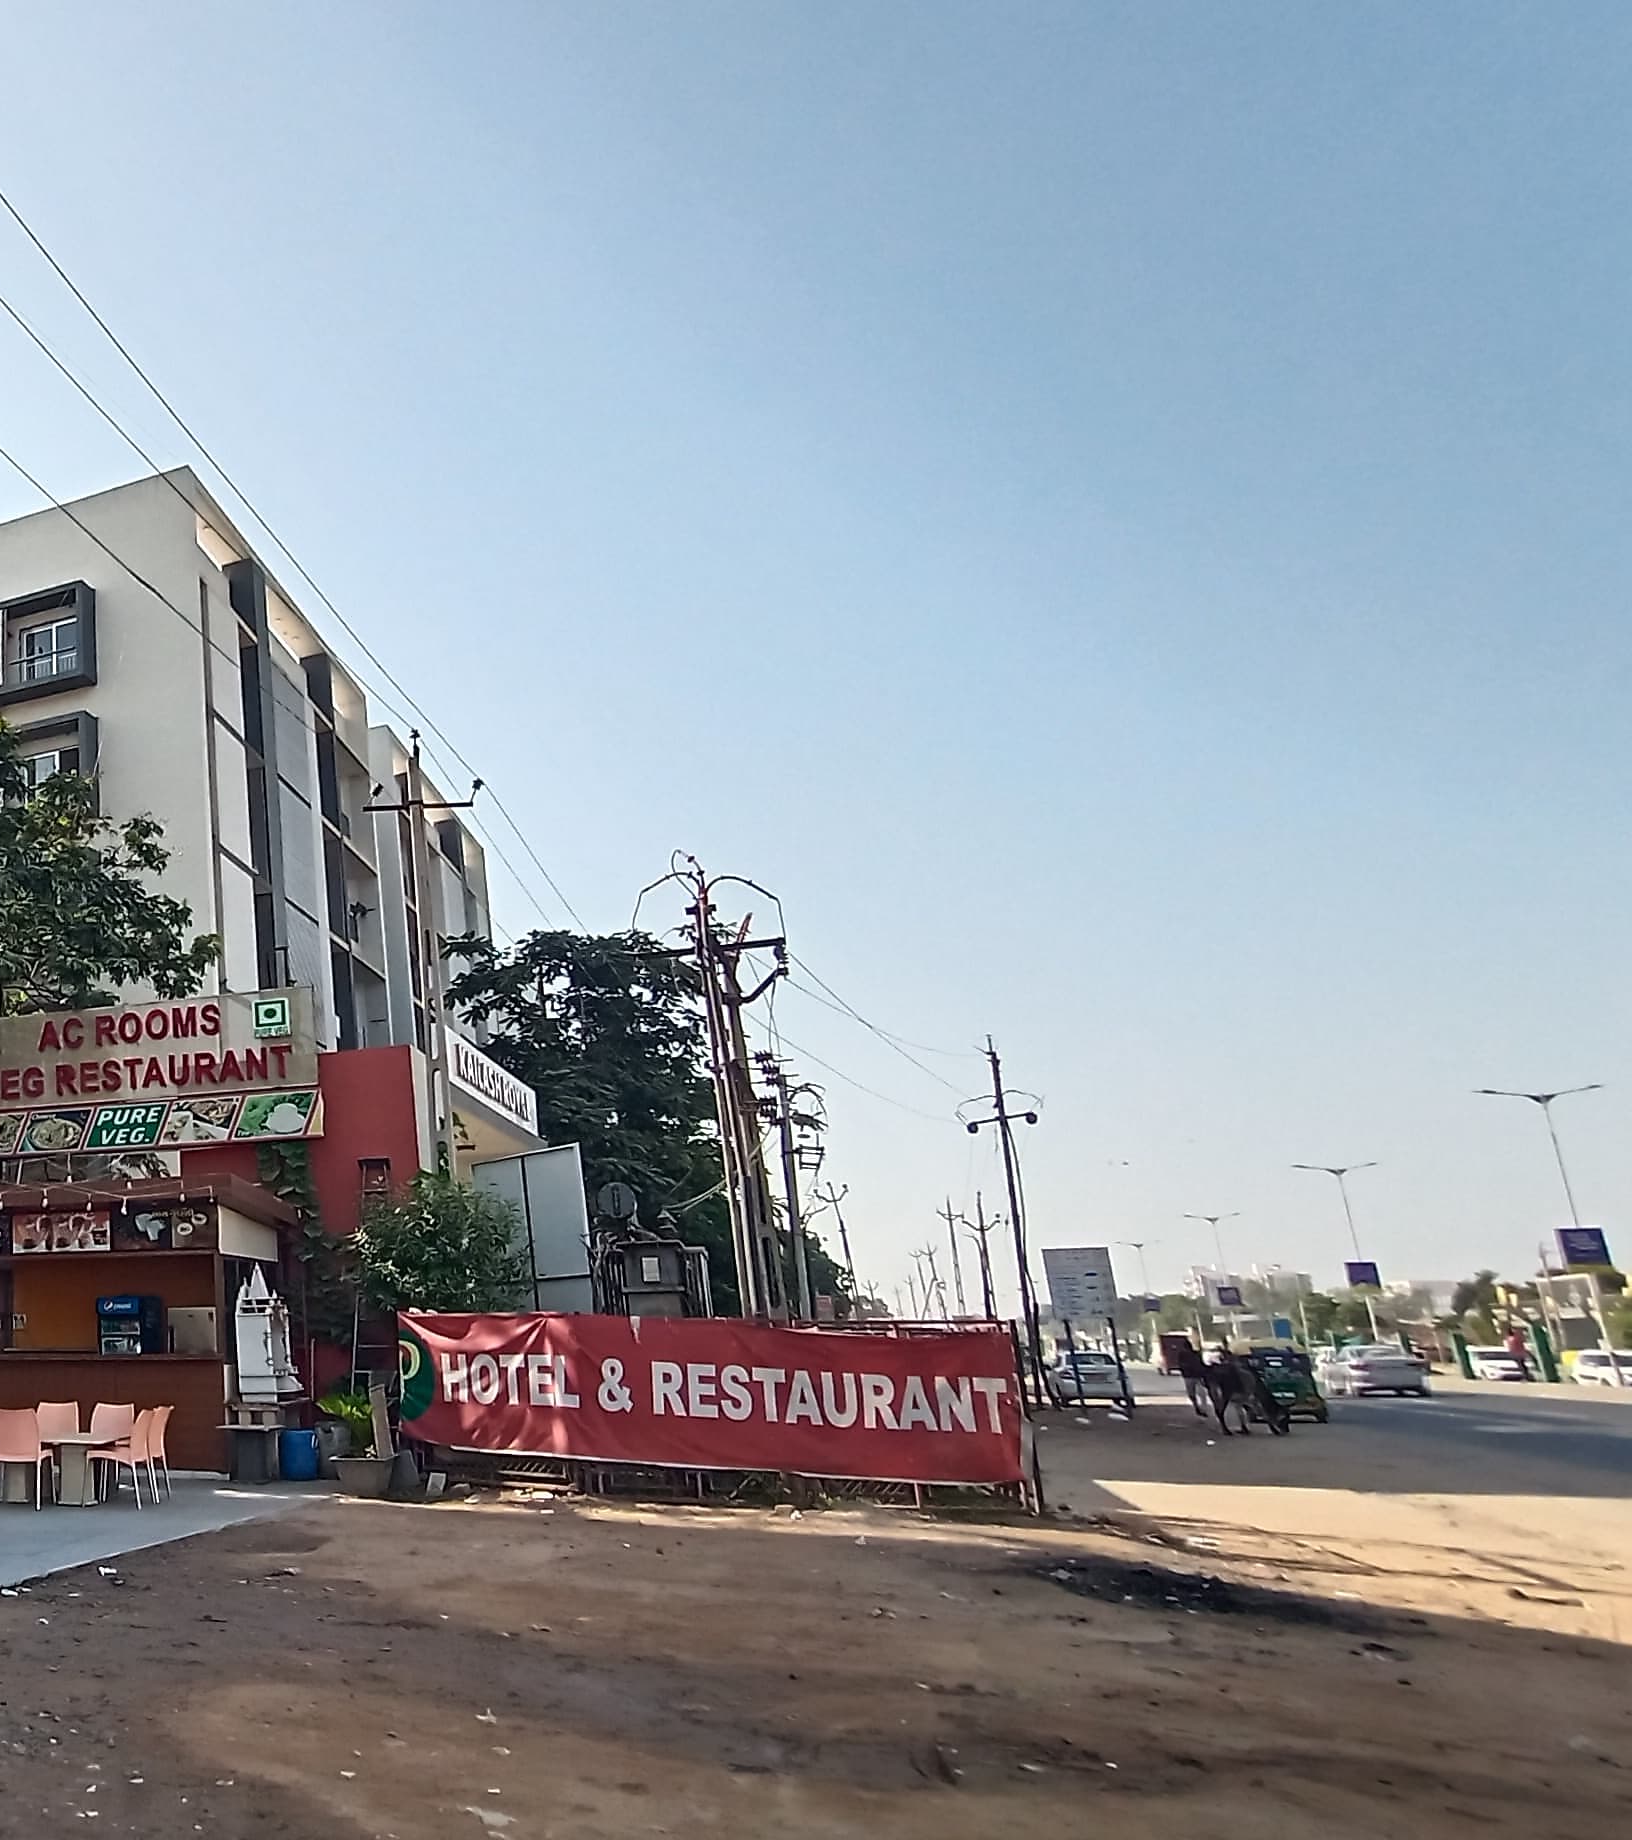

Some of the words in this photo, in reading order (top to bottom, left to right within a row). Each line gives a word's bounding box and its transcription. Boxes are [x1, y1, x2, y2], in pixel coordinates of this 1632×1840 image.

[38, 1018, 84, 1051] AC
[96, 1003, 220, 1047] ROOMS
[56, 1044, 293, 1097] RESTAURANT
[97, 1107, 161, 1126] PURE
[102, 1127, 149, 1144] VEG.
[440, 1353, 580, 1408] HOTEL
[598, 1358, 633, 1413] &
[651, 1361, 1007, 1434] RESTAURANT
